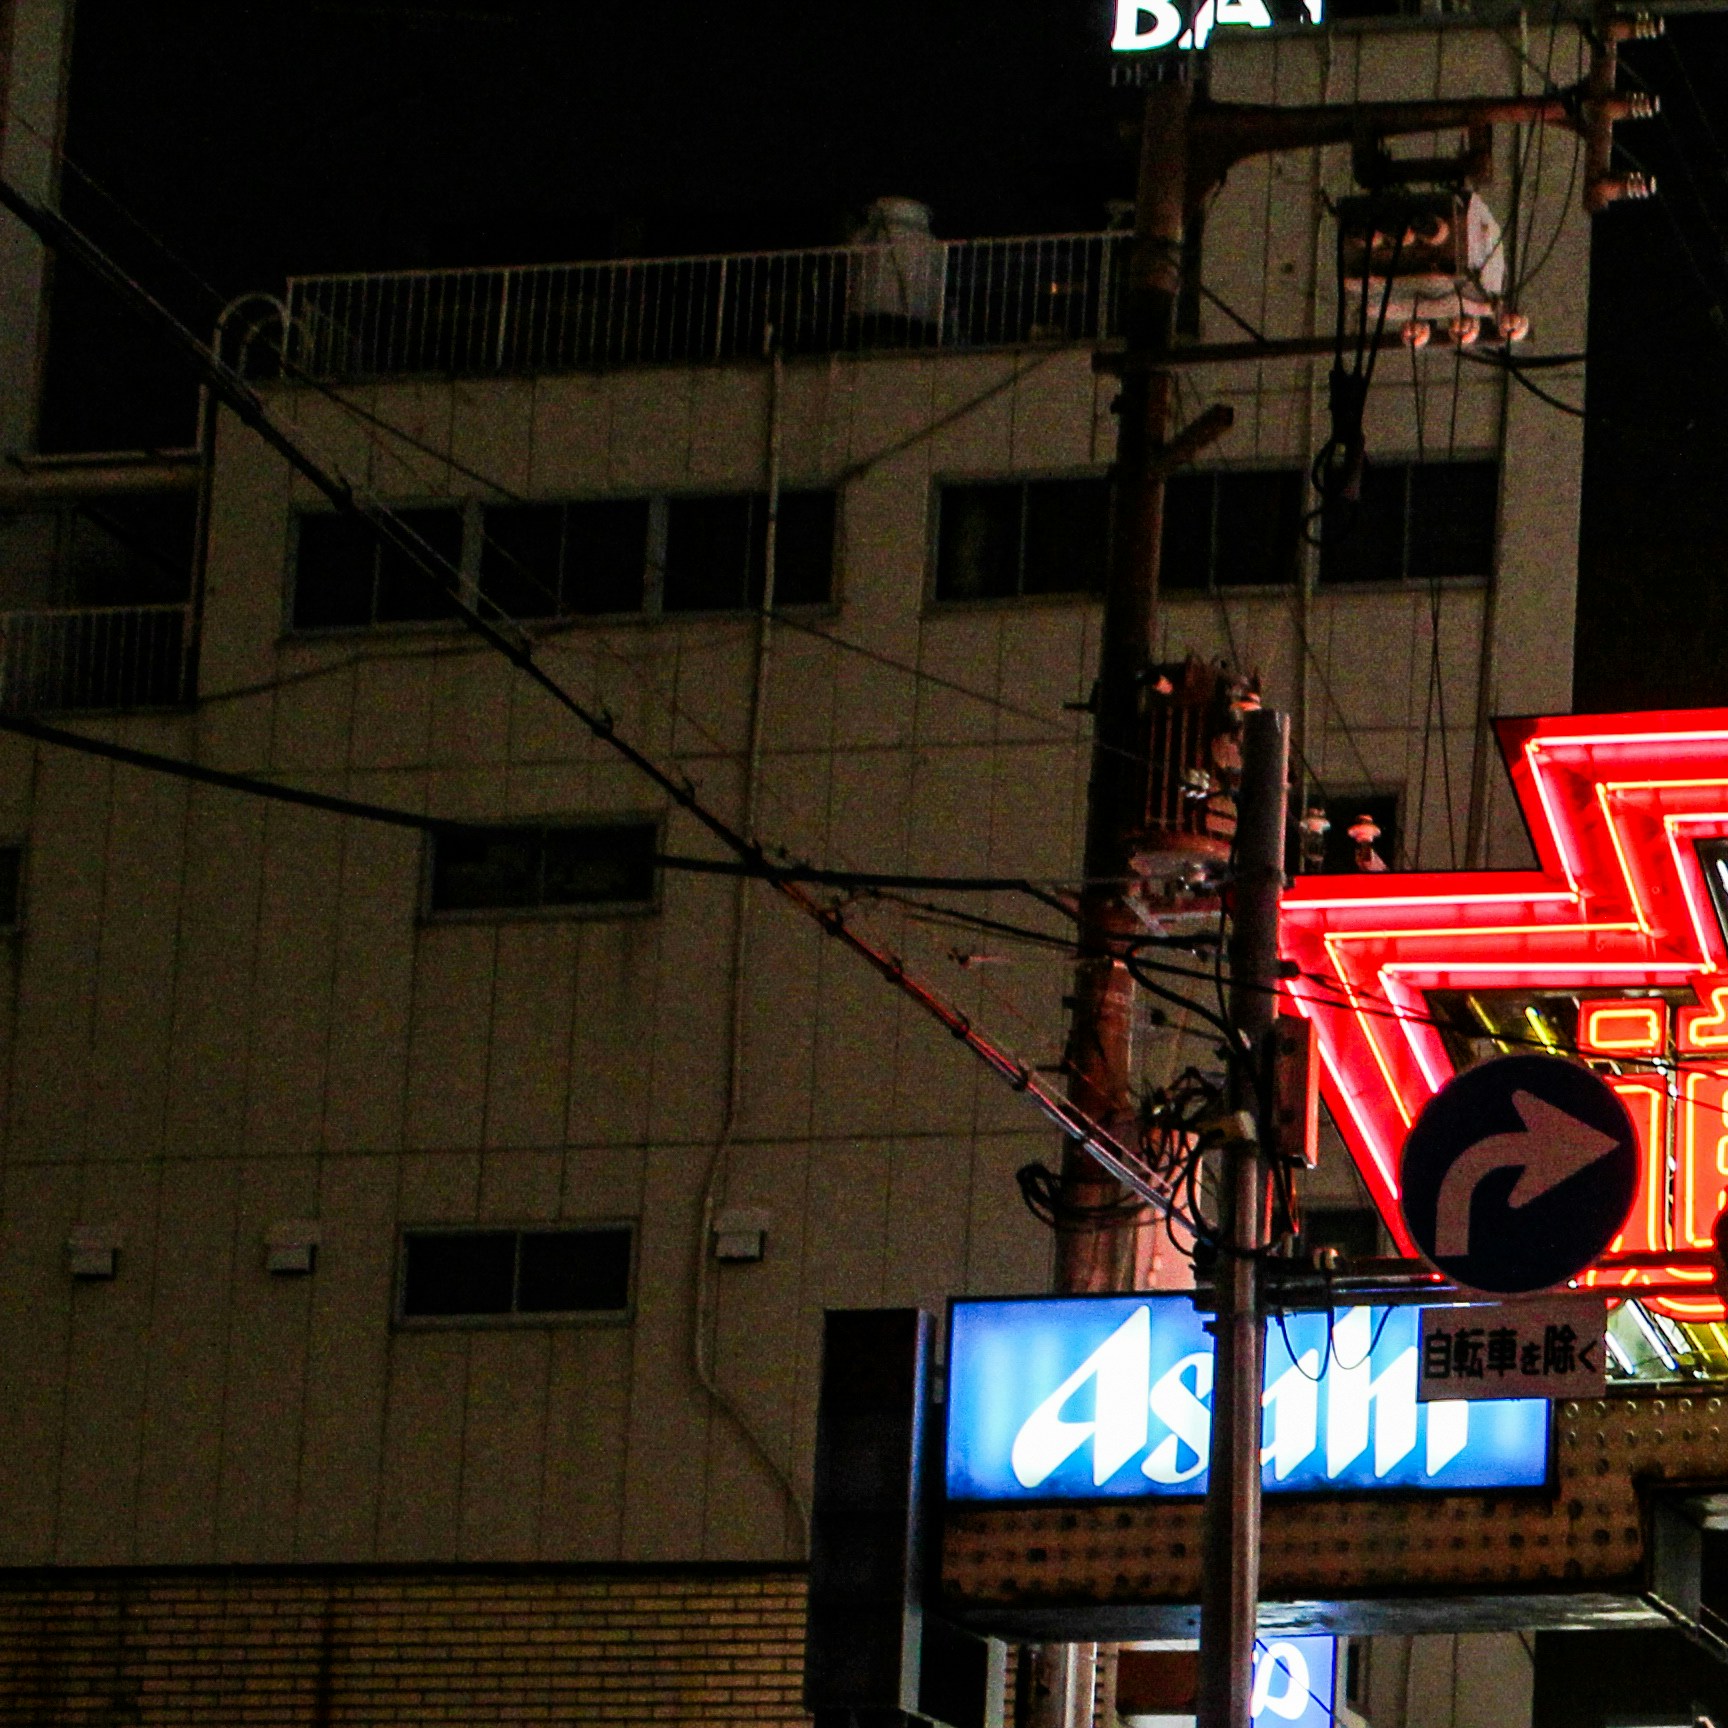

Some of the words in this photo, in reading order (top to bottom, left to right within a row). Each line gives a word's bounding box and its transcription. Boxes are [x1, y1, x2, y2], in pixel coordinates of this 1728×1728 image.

[1422, 1327, 1600, 1382] 自転車を除く
